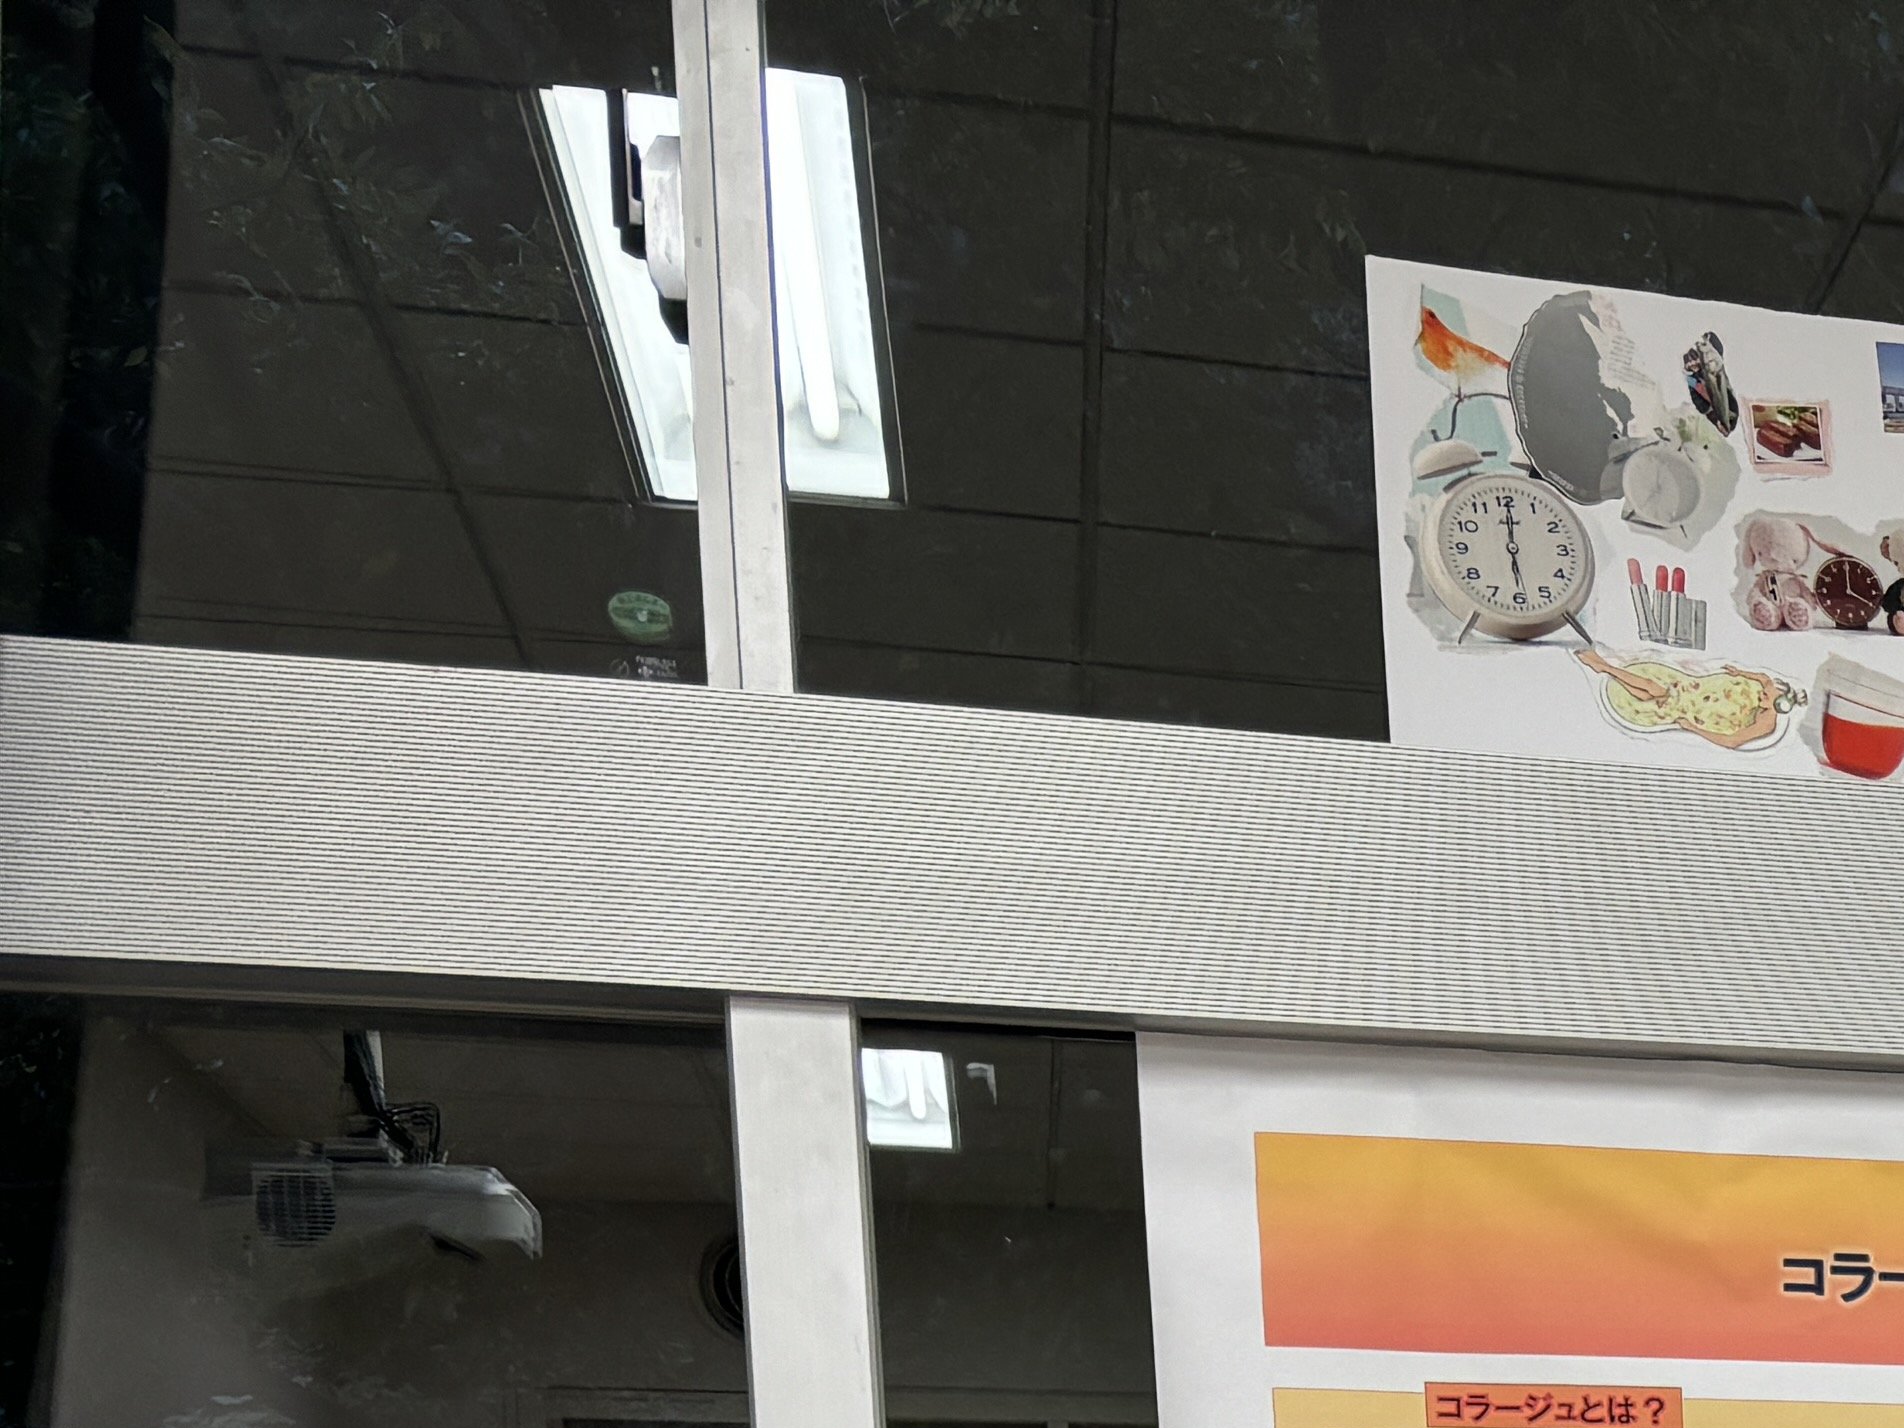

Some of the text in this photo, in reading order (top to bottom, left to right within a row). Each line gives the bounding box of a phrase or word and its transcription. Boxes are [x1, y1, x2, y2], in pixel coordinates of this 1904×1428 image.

[1436, 1394, 1666, 1427] コラージュとは？
